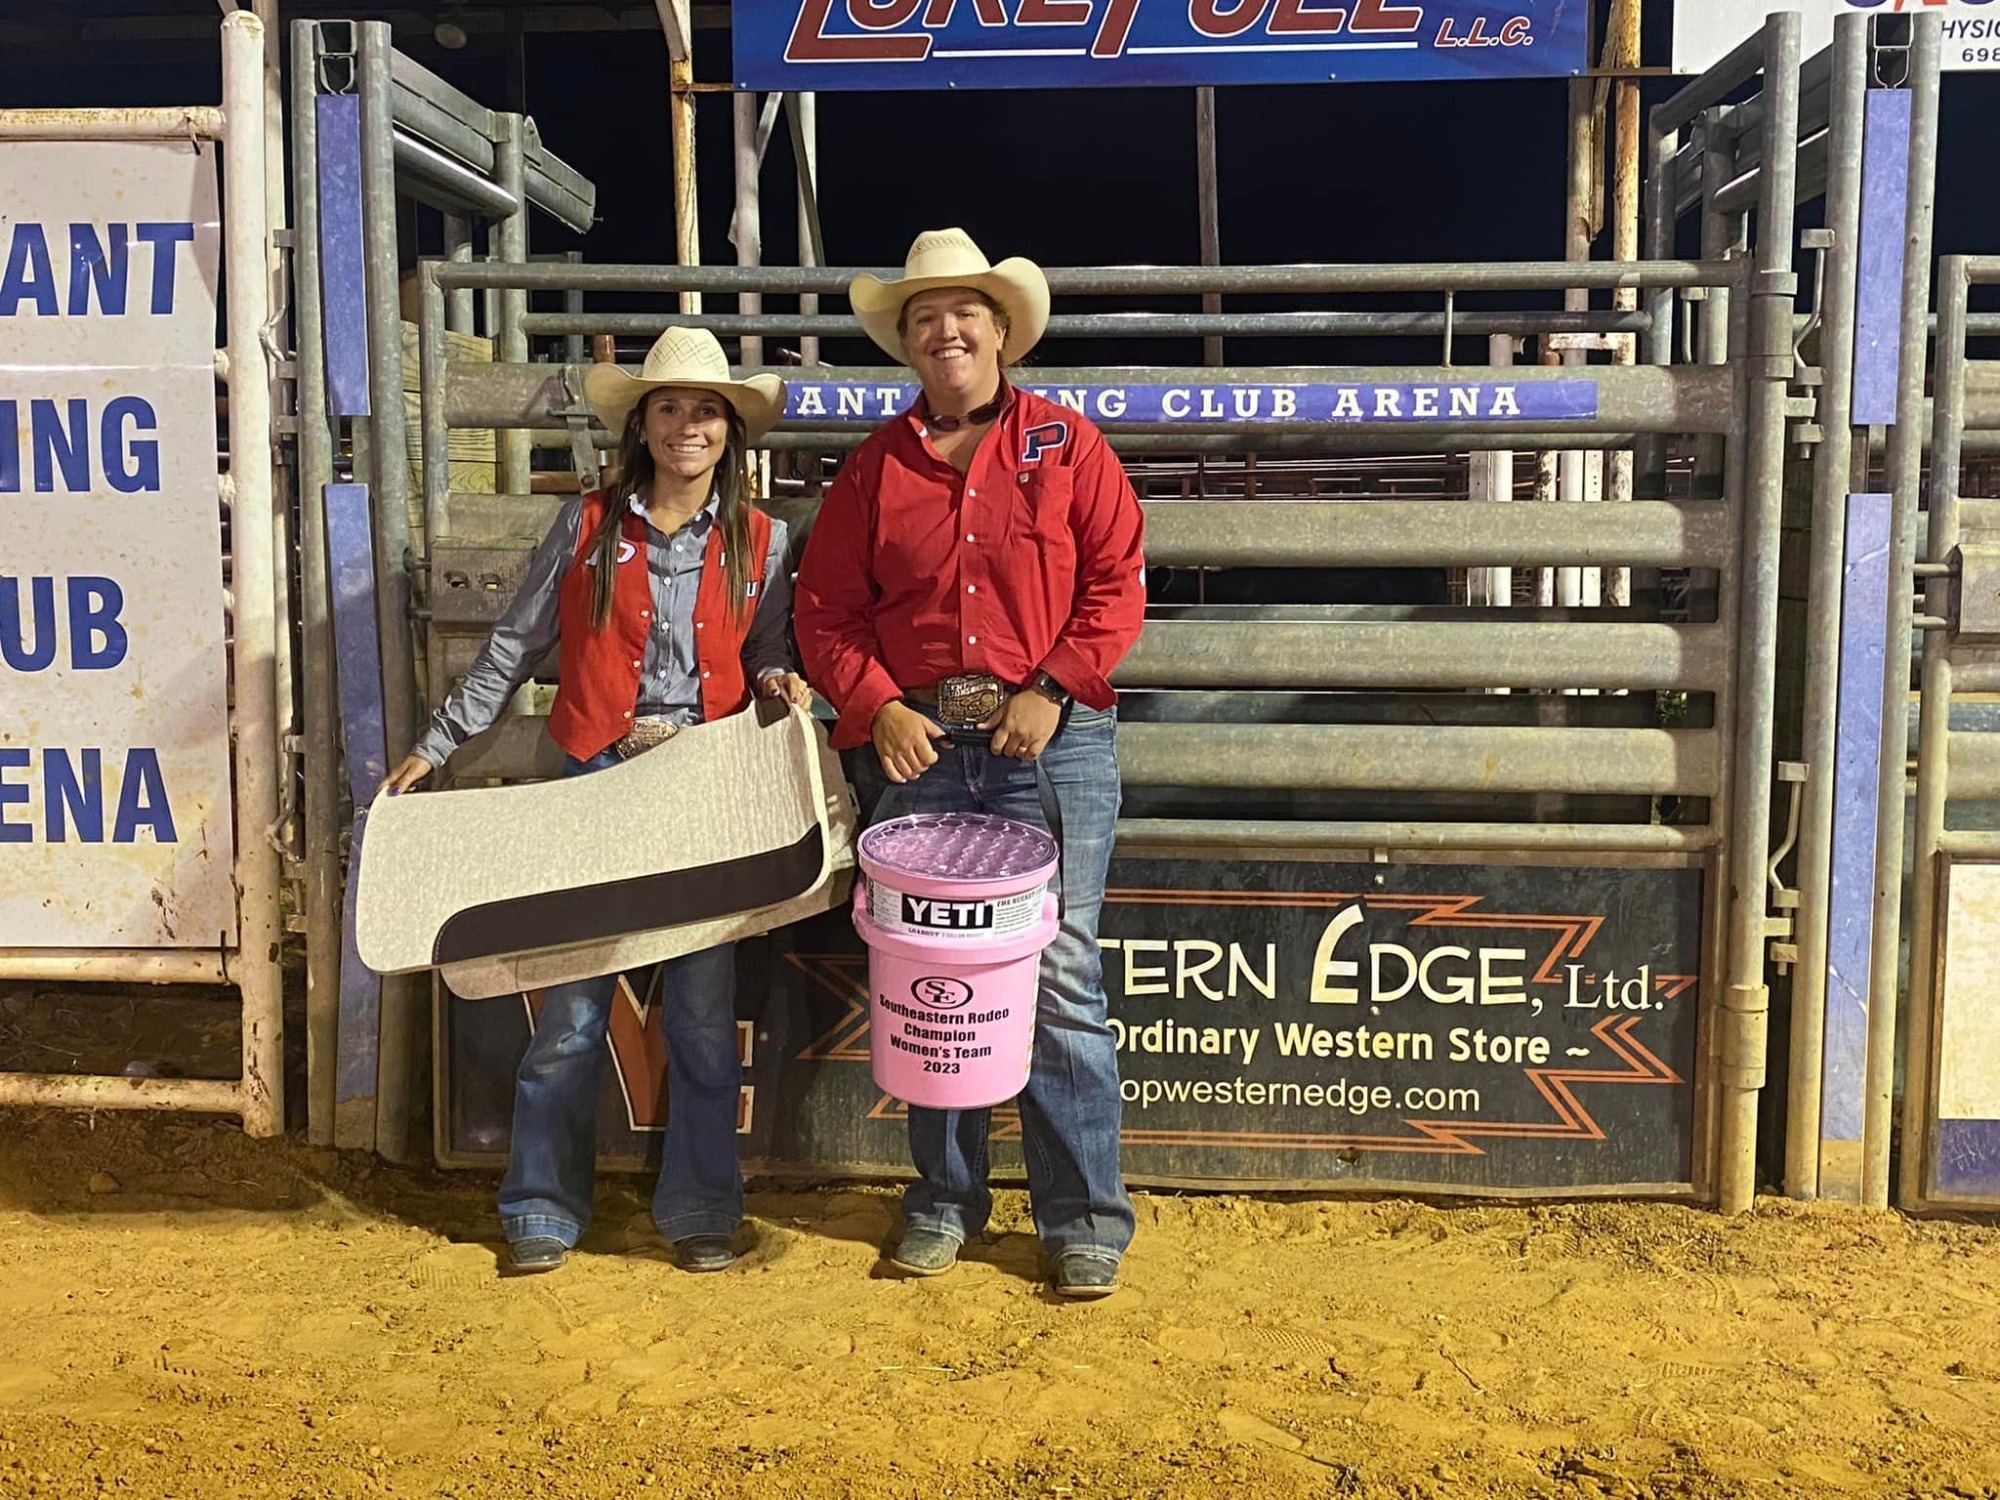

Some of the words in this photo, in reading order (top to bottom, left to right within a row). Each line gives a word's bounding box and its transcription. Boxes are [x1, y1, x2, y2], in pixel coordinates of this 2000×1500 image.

[1434, 18, 1534, 47] L.L.C.
[0, 222, 194, 316] ANT
[783, 386, 901, 416] ANT
[1034, 389, 1128, 418] NG
[1161, 388, 1297, 419] CLUB
[1331, 386, 1521, 418] ARENA
[0, 396, 160, 493] ING
[1022, 421, 1067, 462] P
[0, 576, 128, 672] UB
[0, 748, 178, 843] ENA
[907, 897, 985, 927] YETI
[1096, 939, 1276, 1001] ERN
[1563, 964, 1665, 1011] Ltd.
[879, 993, 964, 1025] Southeastern
[968, 1008, 1010, 1024] Rodeo
[890, 1033, 951, 1059] Women's
[954, 1046, 992, 1059] Team
[904, 1022, 976, 1043] Champion
[1274, 1022, 1433, 1061] Western
[1449, 1027, 1551, 1064] Store
[923, 1060, 960, 1075] 2023
